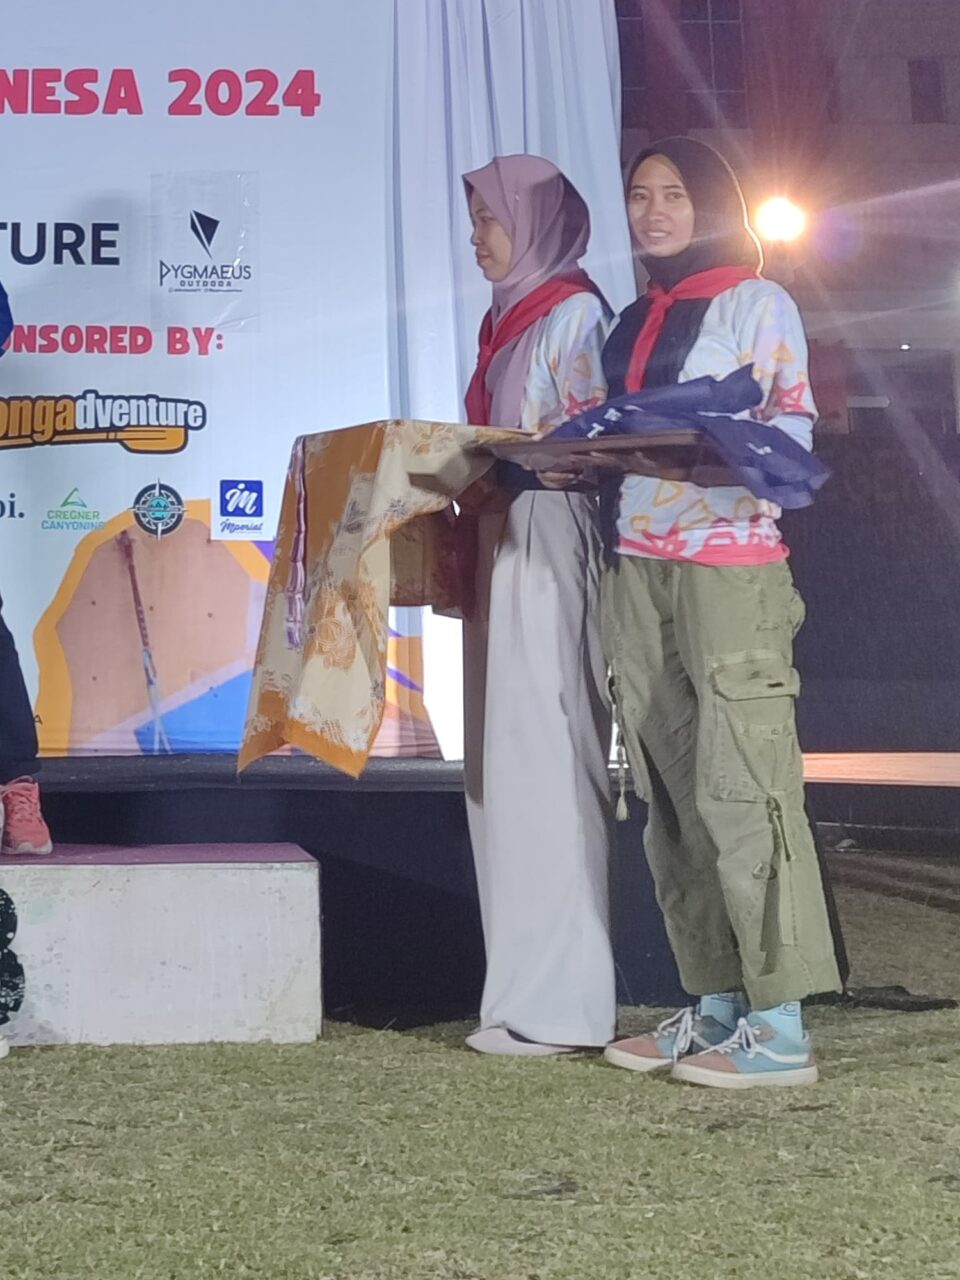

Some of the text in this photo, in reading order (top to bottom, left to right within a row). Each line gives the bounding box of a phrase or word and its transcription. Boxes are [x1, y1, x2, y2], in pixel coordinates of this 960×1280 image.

[167, 68, 321, 117] 2024
[159, 259, 252, 288] PYGMAEUS
[3, 324, 153, 354] NSORED
[166, 326, 224, 356] BY:
[46, 510, 100, 520] CREGNER
